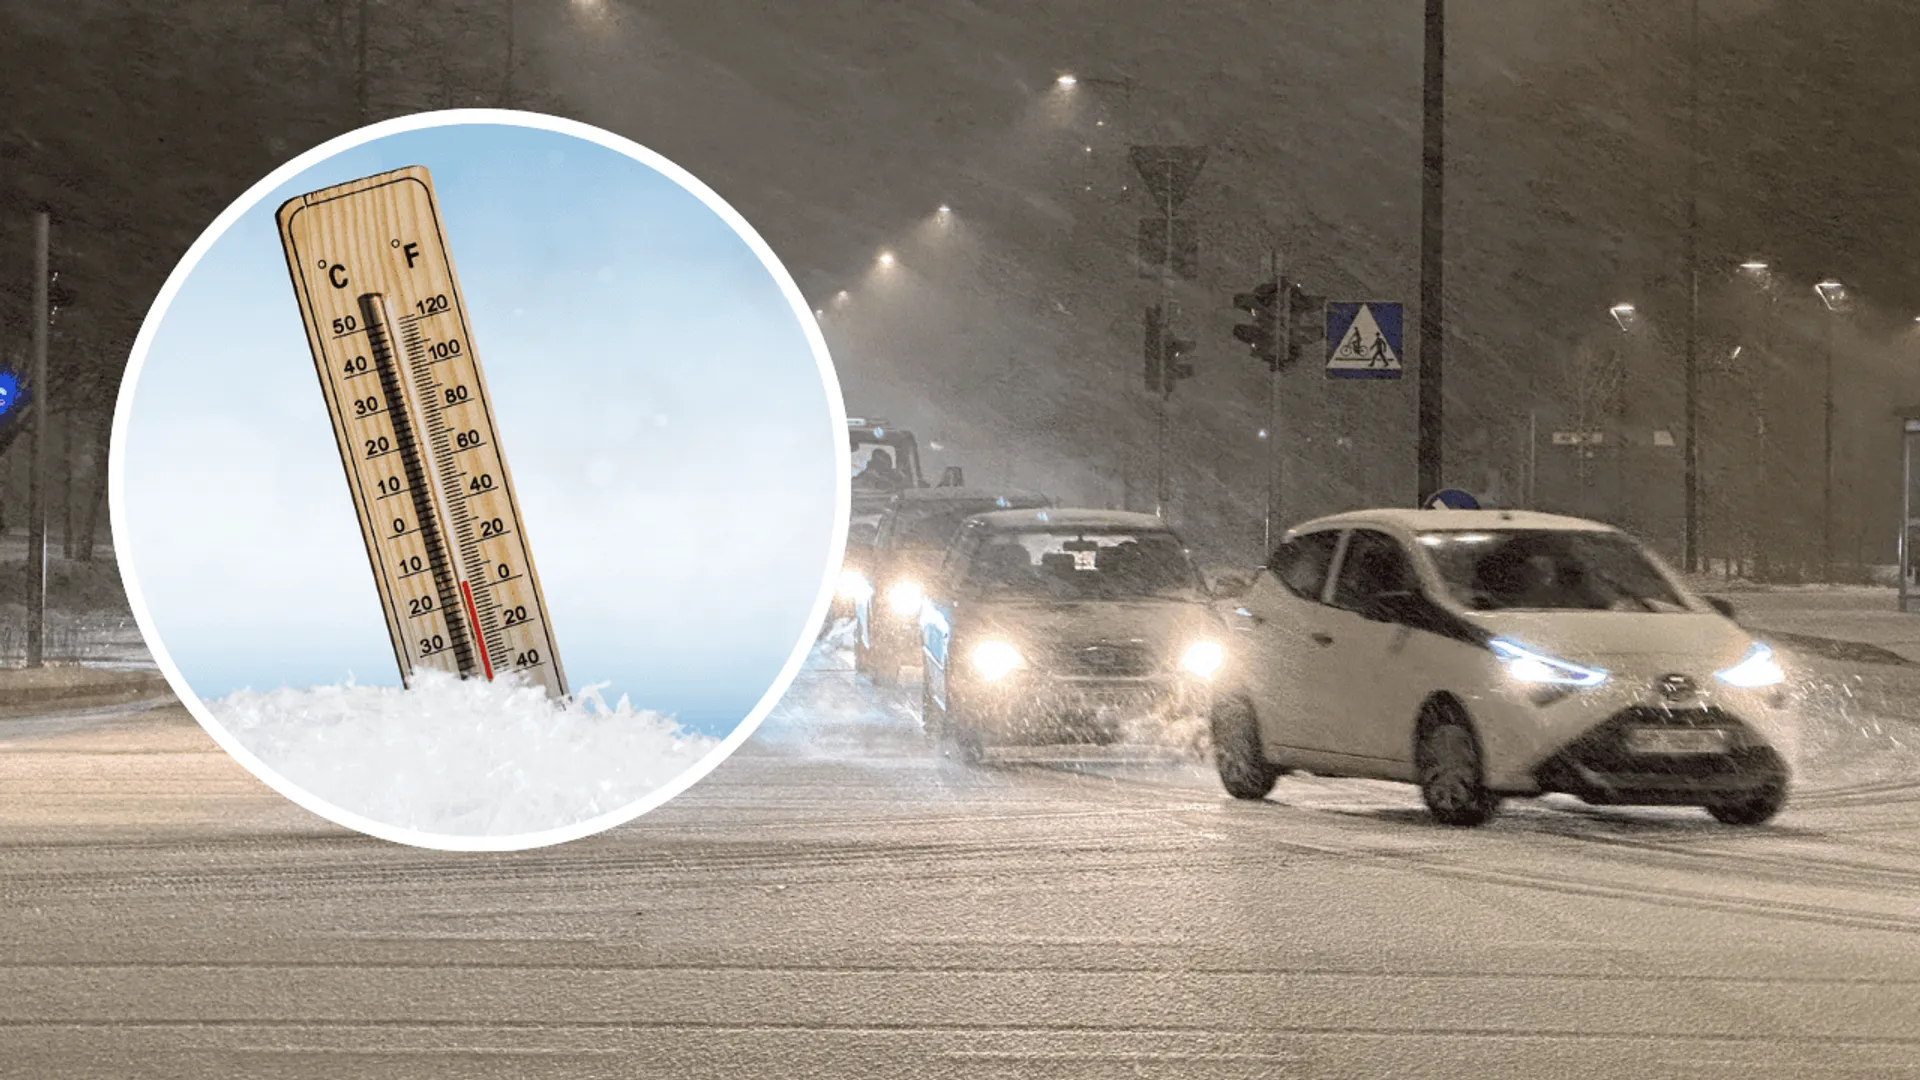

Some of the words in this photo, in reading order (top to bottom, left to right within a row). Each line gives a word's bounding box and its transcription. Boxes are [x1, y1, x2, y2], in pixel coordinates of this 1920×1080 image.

[416, 294, 448, 315] 120
[332, 315, 357, 334] 50
[428, 339, 460, 360] 100
[343, 356, 367, 375] 40
[445, 385, 468, 404] 80
[354, 396, 378, 415] 30
[365, 436, 389, 456] 20
[456, 429, 480, 448] 60
[377, 476, 400, 495] 10
[469, 473, 492, 492] 40
[393, 518, 405, 533] 0
[480, 517, 504, 537] 20
[399, 556, 422, 575] 10
[497, 563, 510, 579] 0
[409, 595, 432, 615] 20
[503, 605, 527, 625] 20
[420, 634, 443, 654] 30
[516, 649, 539, 668] 40
